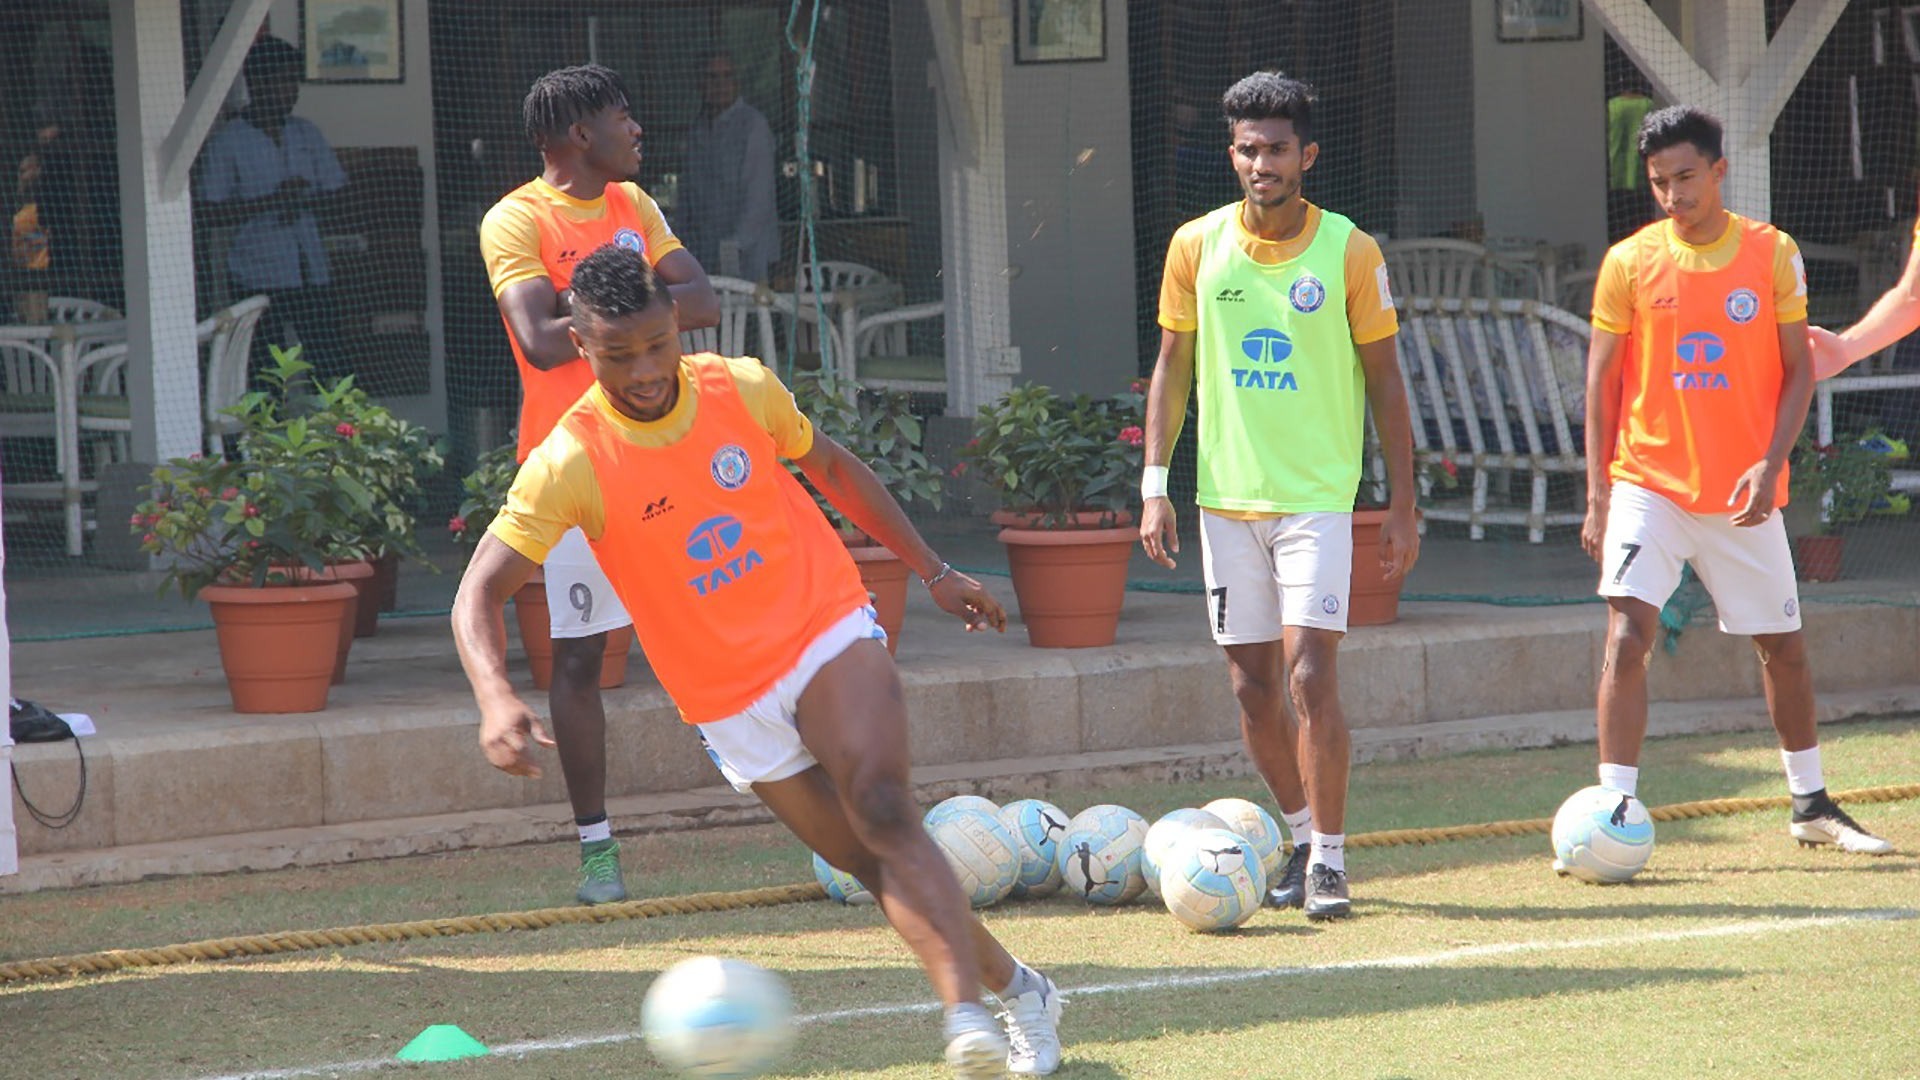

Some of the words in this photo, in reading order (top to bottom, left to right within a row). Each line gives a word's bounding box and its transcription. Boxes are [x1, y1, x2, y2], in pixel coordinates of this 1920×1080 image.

[1231, 369, 1298, 390] TATA
[1673, 373, 1730, 390] TATA
[688, 549, 763, 595] TATA
[1612, 542, 1642, 585] 7
[569, 582, 593, 622] 9
